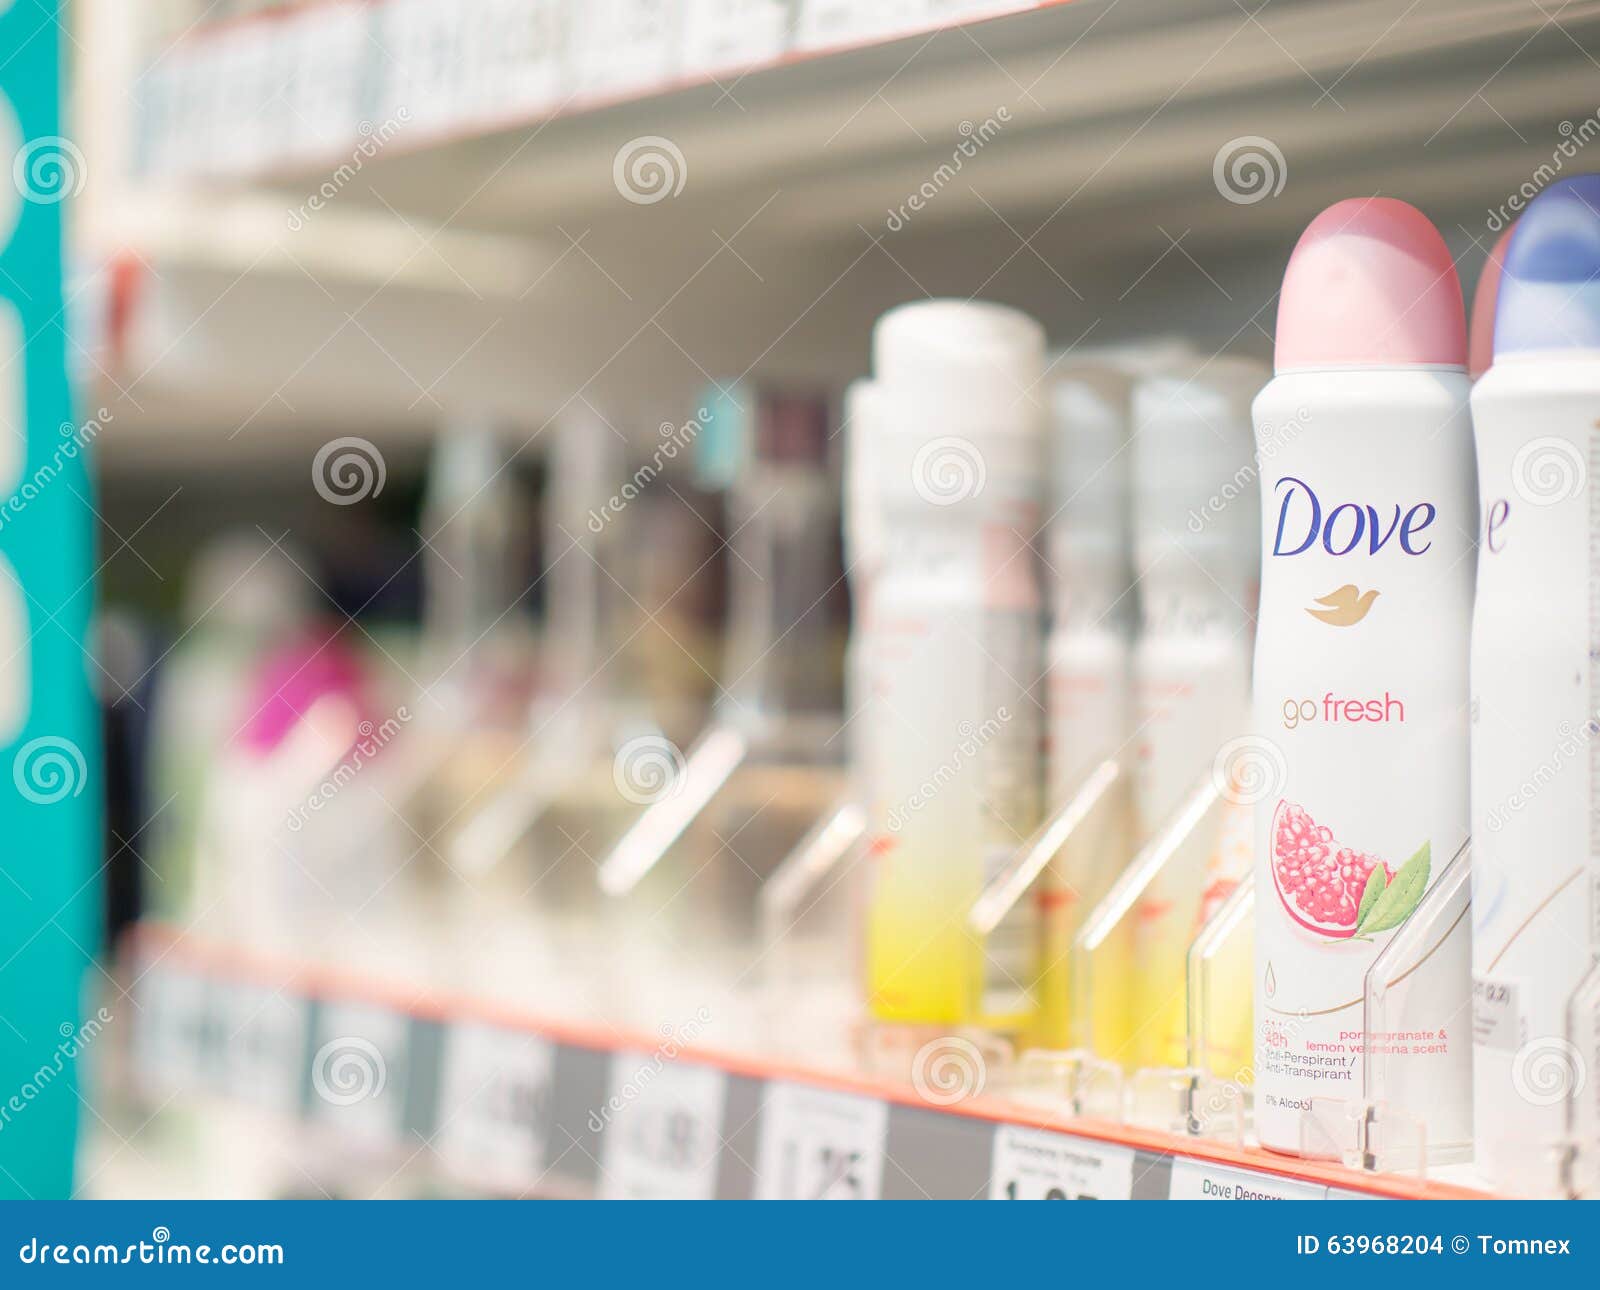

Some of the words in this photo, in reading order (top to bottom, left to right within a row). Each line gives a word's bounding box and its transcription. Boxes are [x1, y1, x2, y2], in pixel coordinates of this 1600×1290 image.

[1272, 476, 1436, 556] Dove
[1283, 698, 1317, 729] go
[1323, 692, 1404, 722] fresh
[1340, 1029, 1434, 1042] pogranate
[1438, 1028, 1447, 1040] &
[1306, 1041, 1345, 1052] lemon
[1349, 1043, 1408, 1054] vena
[1412, 1043, 1447, 1054] scent
[1202, 1179, 1232, 1199] Dove
